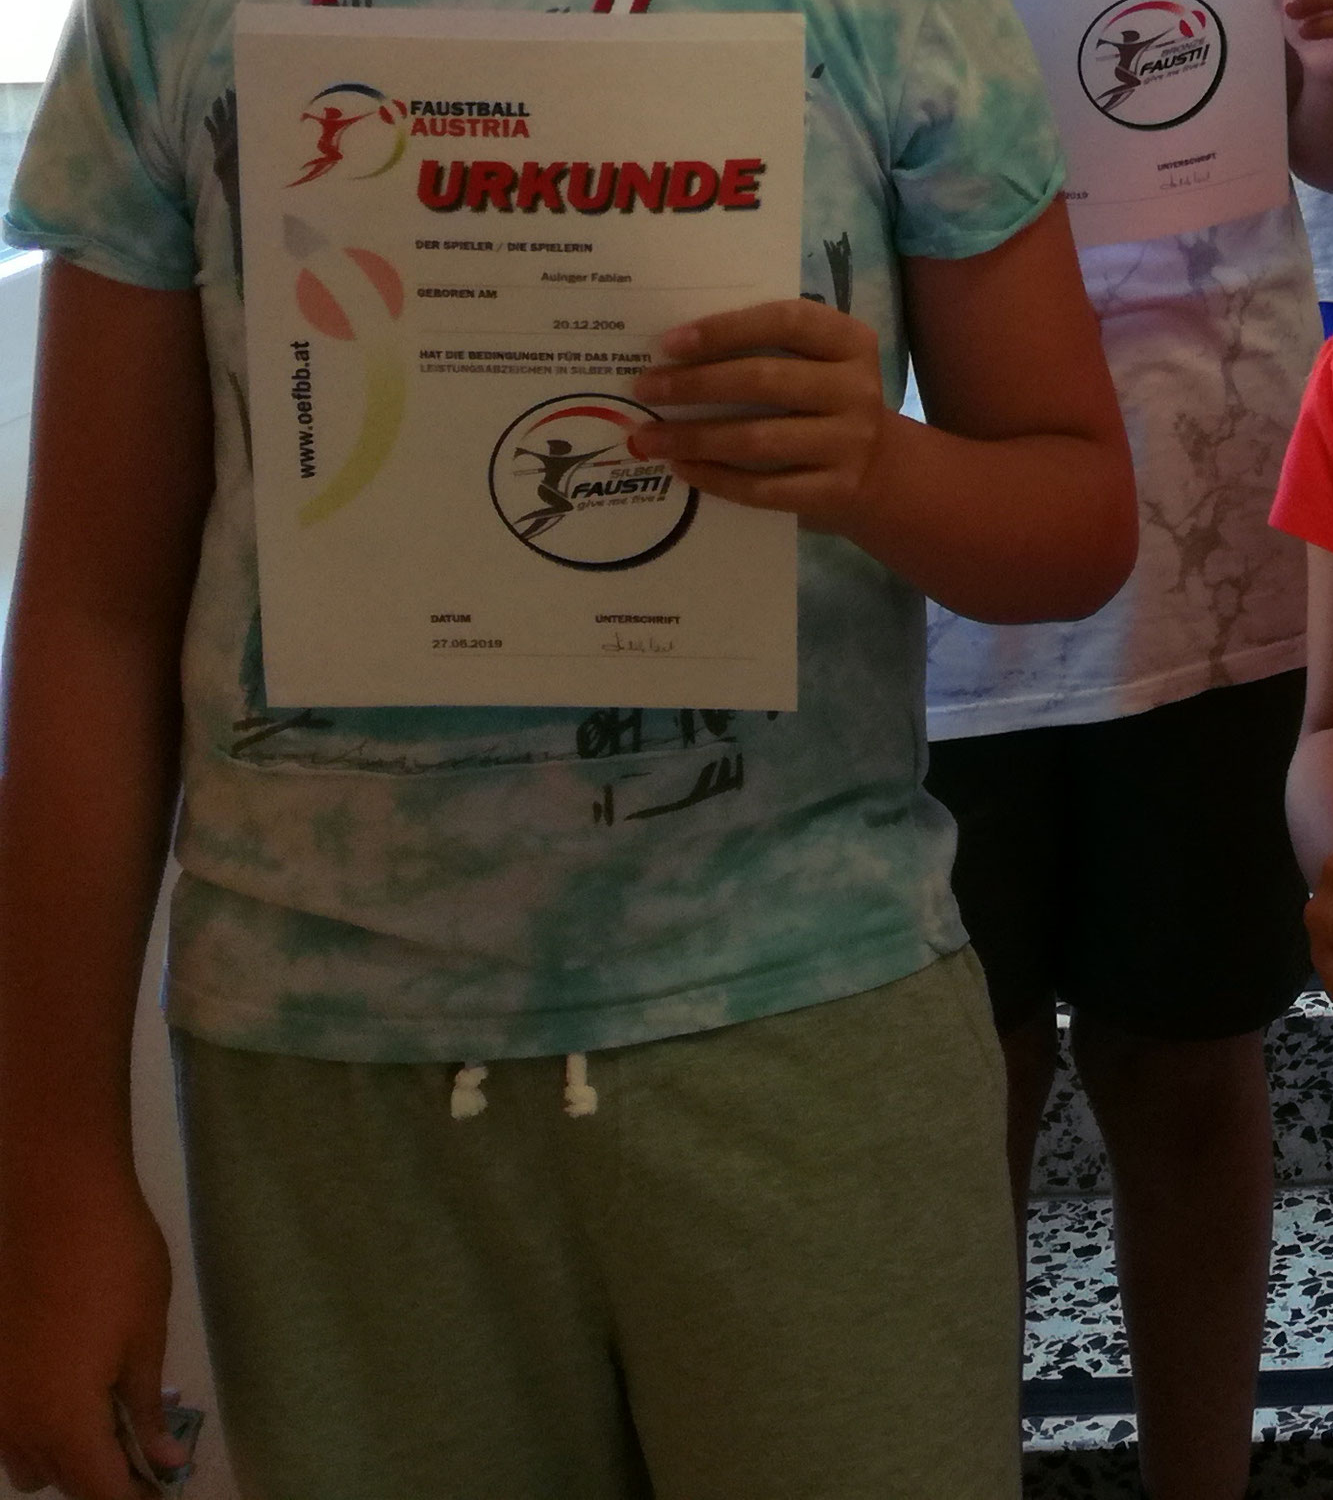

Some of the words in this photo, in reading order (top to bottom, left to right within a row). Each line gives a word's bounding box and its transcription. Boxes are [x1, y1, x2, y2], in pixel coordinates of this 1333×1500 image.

[410, 100, 530, 118] FAUSTBALL
[410, 118, 530, 138] AUSTRIA
[416, 158, 766, 214] URKUNDE
[415, 240, 440, 250] DER
[443, 241, 493, 251] SPIELER
[507, 242, 527, 252] DIE
[530, 242, 593, 252] SPIELERIN
[591, 272, 632, 283] Fabian
[416, 288, 475, 298] GEBOREN
[478, 289, 498, 299] AM
[419, 350, 443, 360] HAT
[445, 350, 465, 360] DIE
[468, 351, 554, 361] BEDINGUNGEN
[558, 350, 581, 362] FÜR
[585, 352, 608, 362] DAS
[291, 340, 316, 479] www.oefbb.at
[611, 465, 665, 478] SILBER
[430, 615, 472, 623] DATUM
[595, 615, 681, 624] UNTERSCHRIFT
